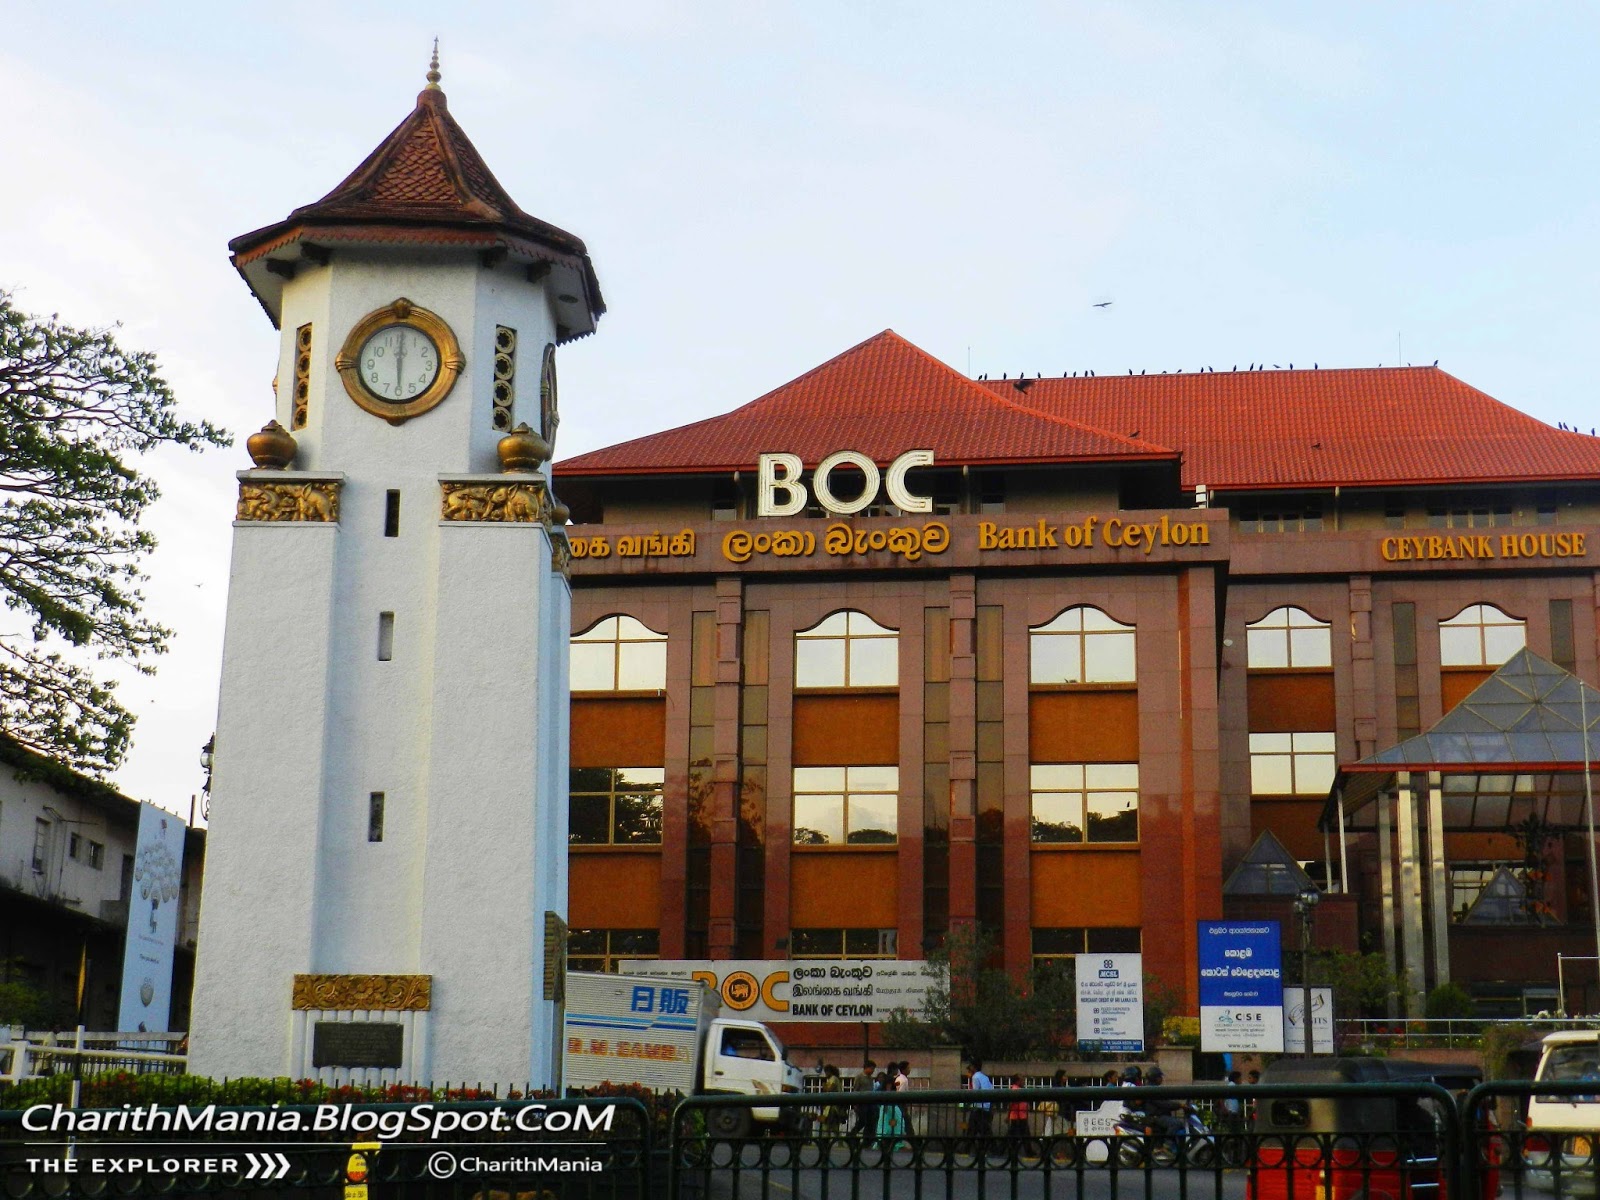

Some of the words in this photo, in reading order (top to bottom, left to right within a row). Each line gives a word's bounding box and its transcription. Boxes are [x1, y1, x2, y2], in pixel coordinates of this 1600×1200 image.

[374, 346, 385, 358] 10
[421, 346, 428, 358] 2
[367, 359, 375, 370] 9
[426, 360, 433, 371] 3
[371, 373, 379, 384] 8
[418, 374, 426, 384] 4
[383, 383, 390, 394] 7
[395, 385, 402, 396] 6
[408, 383, 416, 394] 5
[758, 450, 934, 517] BOC
[978, 518, 1059, 550] Bank
[1064, 515, 1099, 548] of
[1103, 514, 1210, 555] Ceylon
[617, 528, 696, 557] வங்கி
[722, 530, 816, 562] ලංකා
[824, 522, 950, 561] බැංකුව
[1381, 534, 1495, 561] CEYBANK
[1500, 532, 1587, 558] HOUSE
[793, 966, 826, 980] ලංකා
[830, 966, 873, 980] බැංකුව
[792, 984, 842, 997] இலங்கை
[843, 984, 873, 996] வங்கி
[630, 986, 690, 1014] 日販
[792, 1004, 819, 1016] BANK
[820, 1004, 834, 1016] OF
[836, 1004, 873, 1016] CEYLON
